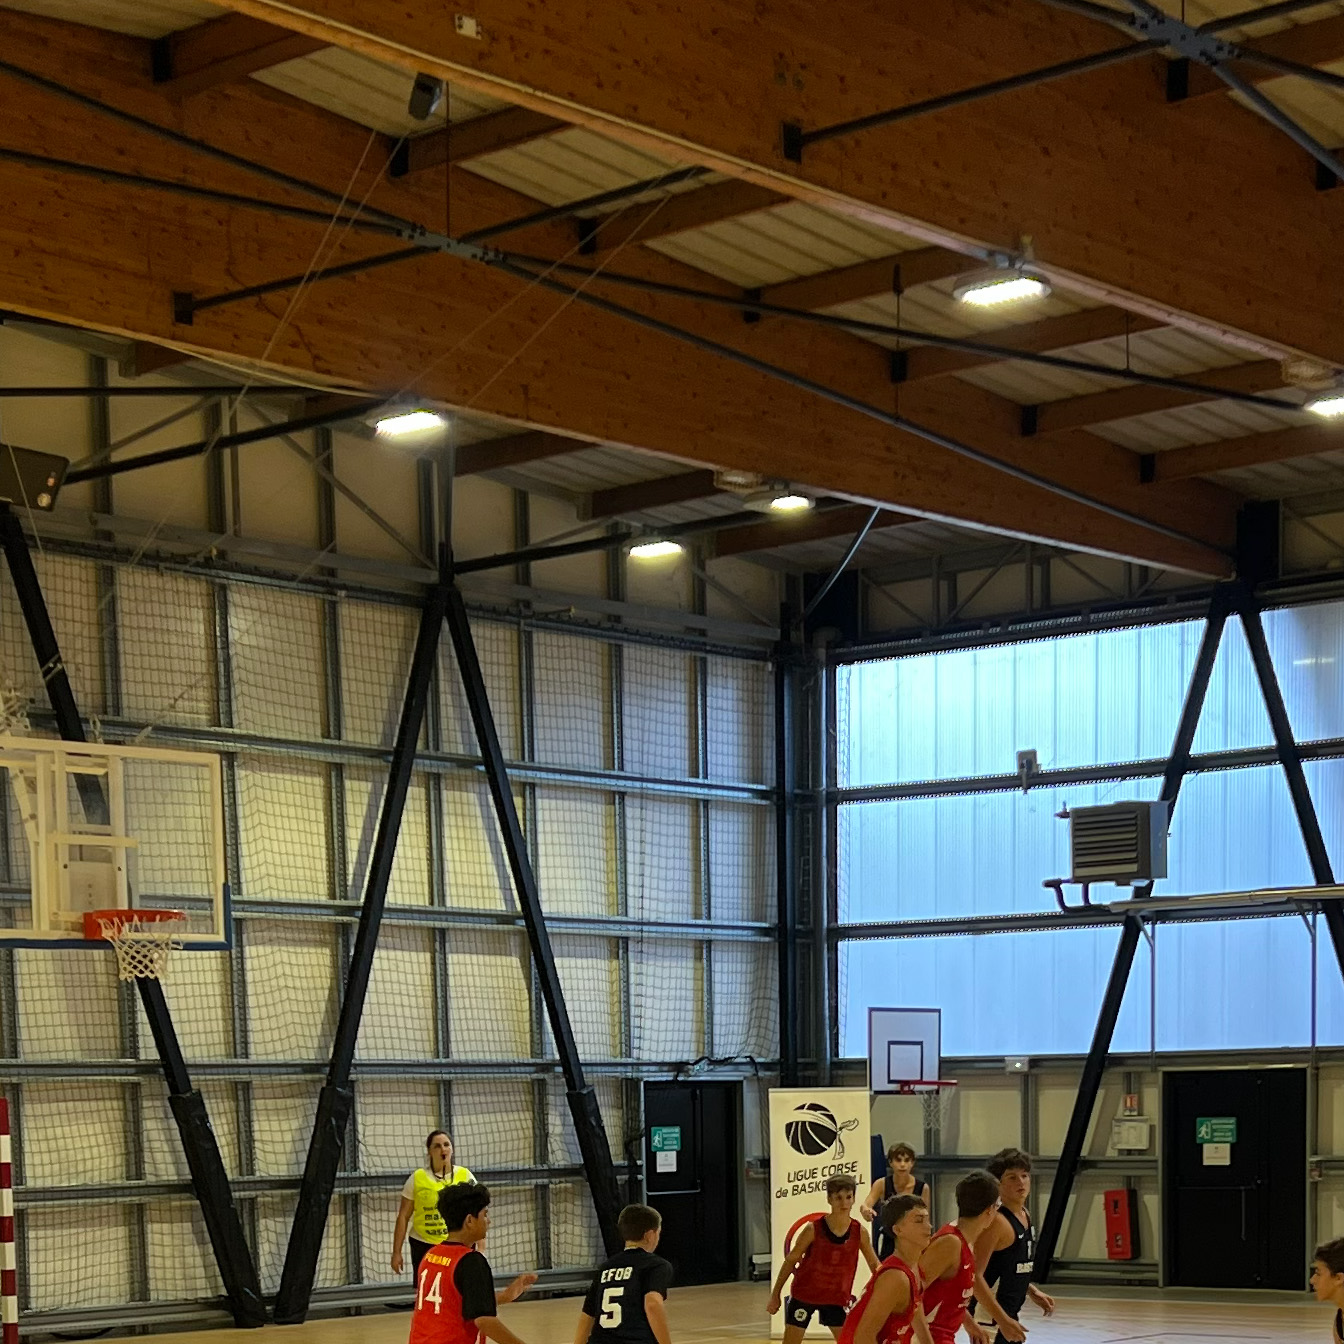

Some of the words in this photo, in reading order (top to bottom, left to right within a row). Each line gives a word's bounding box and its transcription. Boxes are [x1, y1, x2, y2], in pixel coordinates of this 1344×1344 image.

[787, 1167, 818, 1184] LIGUE
[821, 1161, 859, 1177] CORSE
[775, 1186, 789, 1199] de
[601, 1266, 633, 1284] EFOB
[418, 1268, 442, 1314] 14
[599, 1286, 624, 1329] 5
